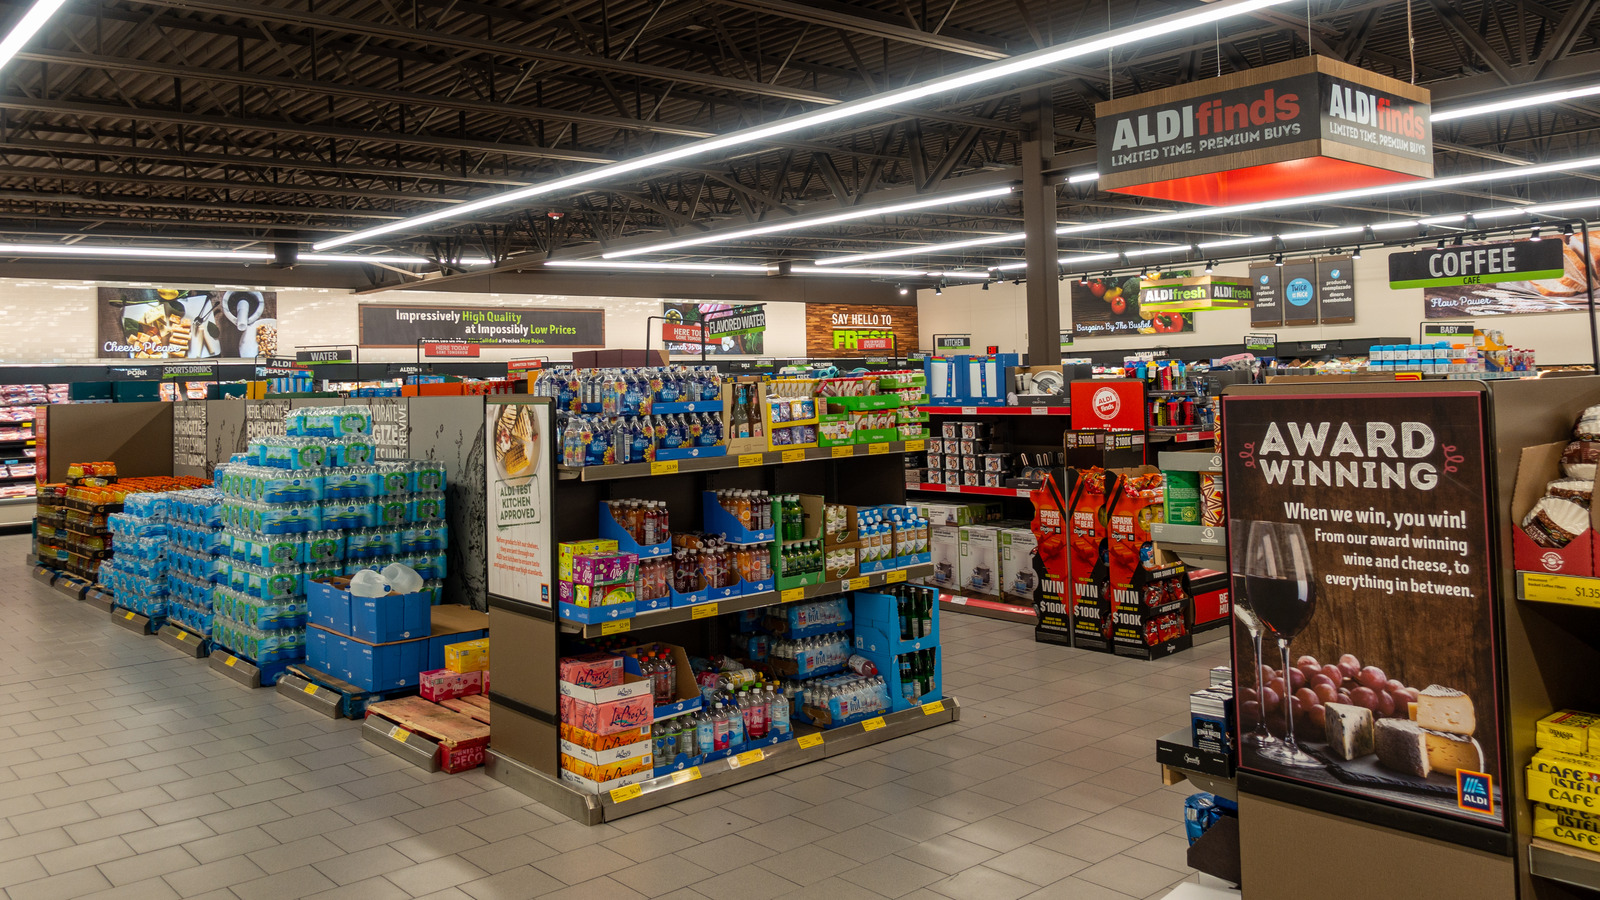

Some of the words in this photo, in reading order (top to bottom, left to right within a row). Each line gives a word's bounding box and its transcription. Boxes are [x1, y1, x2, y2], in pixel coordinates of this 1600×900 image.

[1111, 148, 1159, 166] LIMITED
[1162, 142, 1196, 158] TIME,
[1199, 130, 1260, 152] PREMIUM
[1264, 123, 1301, 138] BUYS
[1330, 122, 1358, 138] LIMITED
[1360, 128, 1378, 145] TIME,
[1380, 134, 1408, 152] PREMIUM
[1410, 143, 1426, 156] BUYS
[1429, 247, 1516, 278] COFFEE
[1463, 276, 1480, 284] CAFÉ
[1145, 286, 1206, 302] ALDIfresh
[1431, 298, 1458, 308] Flour
[1459, 296, 1491, 306] Power
[396, 309, 460, 324] Impressively
[462, 310, 485, 324] High
[487, 312, 522, 324] Quality
[832, 314, 848, 324] SAY
[852, 314, 878, 325] HELLO
[881, 314, 892, 325] TO
[465, 324, 476, 334] at
[478, 324, 528, 337] Impossibly
[530, 324, 547, 334] Low
[550, 325, 576, 335] Prices
[710, 318, 740, 334] FLAVORED
[741, 314, 765, 328] WATER
[1105, 322, 1114, 332] By
[1116, 321, 1128, 329] The
[104, 342, 142, 352] Cheese
[143, 342, 180, 352] Please
[310, 352, 338, 361] WATER
[1099, 396, 1112, 404] ALDI
[1101, 404, 1114, 412] finds
[1259, 421, 1435, 458] AWARD
[1259, 460, 1438, 490] WINNING
[500, 486, 515, 496] ALDI
[516, 484, 532, 494] TEST
[502, 496, 531, 508] KITCHEN
[500, 508, 535, 521] APPROVED
[1040, 510, 1059, 518] SPARK
[1074, 512, 1093, 520] SPARK
[1112, 516, 1132, 525] SPARK
[1284, 502, 1328, 521] When
[1330, 508, 1352, 523] we
[1356, 507, 1391, 528] win,
[1394, 511, 1425, 531] you
[1428, 510, 1466, 529] win!
[1315, 528, 1345, 543] From
[1347, 533, 1367, 545] our
[1370, 532, 1410, 548] award
[1412, 535, 1468, 556] winning
[1343, 553, 1373, 568] wine
[1375, 554, 1399, 569] and
[1401, 556, 1452, 576] cheese,
[1454, 560, 1469, 574] to
[1042, 579, 1064, 594] WIN
[1075, 583, 1098, 598] WIN
[1325, 573, 1393, 595] everything
[1395, 578, 1408, 592] in
[1410, 579, 1474, 598] between.
[1576, 586, 1600, 598] $1.35
[1114, 589, 1139, 604] WIN
[1040, 600, 1066, 614] $100K
[1074, 605, 1100, 619] $100K
[1113, 612, 1141, 626] $100K
[1464, 794, 1487, 805] ALDI
[1549, 788, 1594, 807] CAFE
[1553, 827, 1598, 845] CAFE
